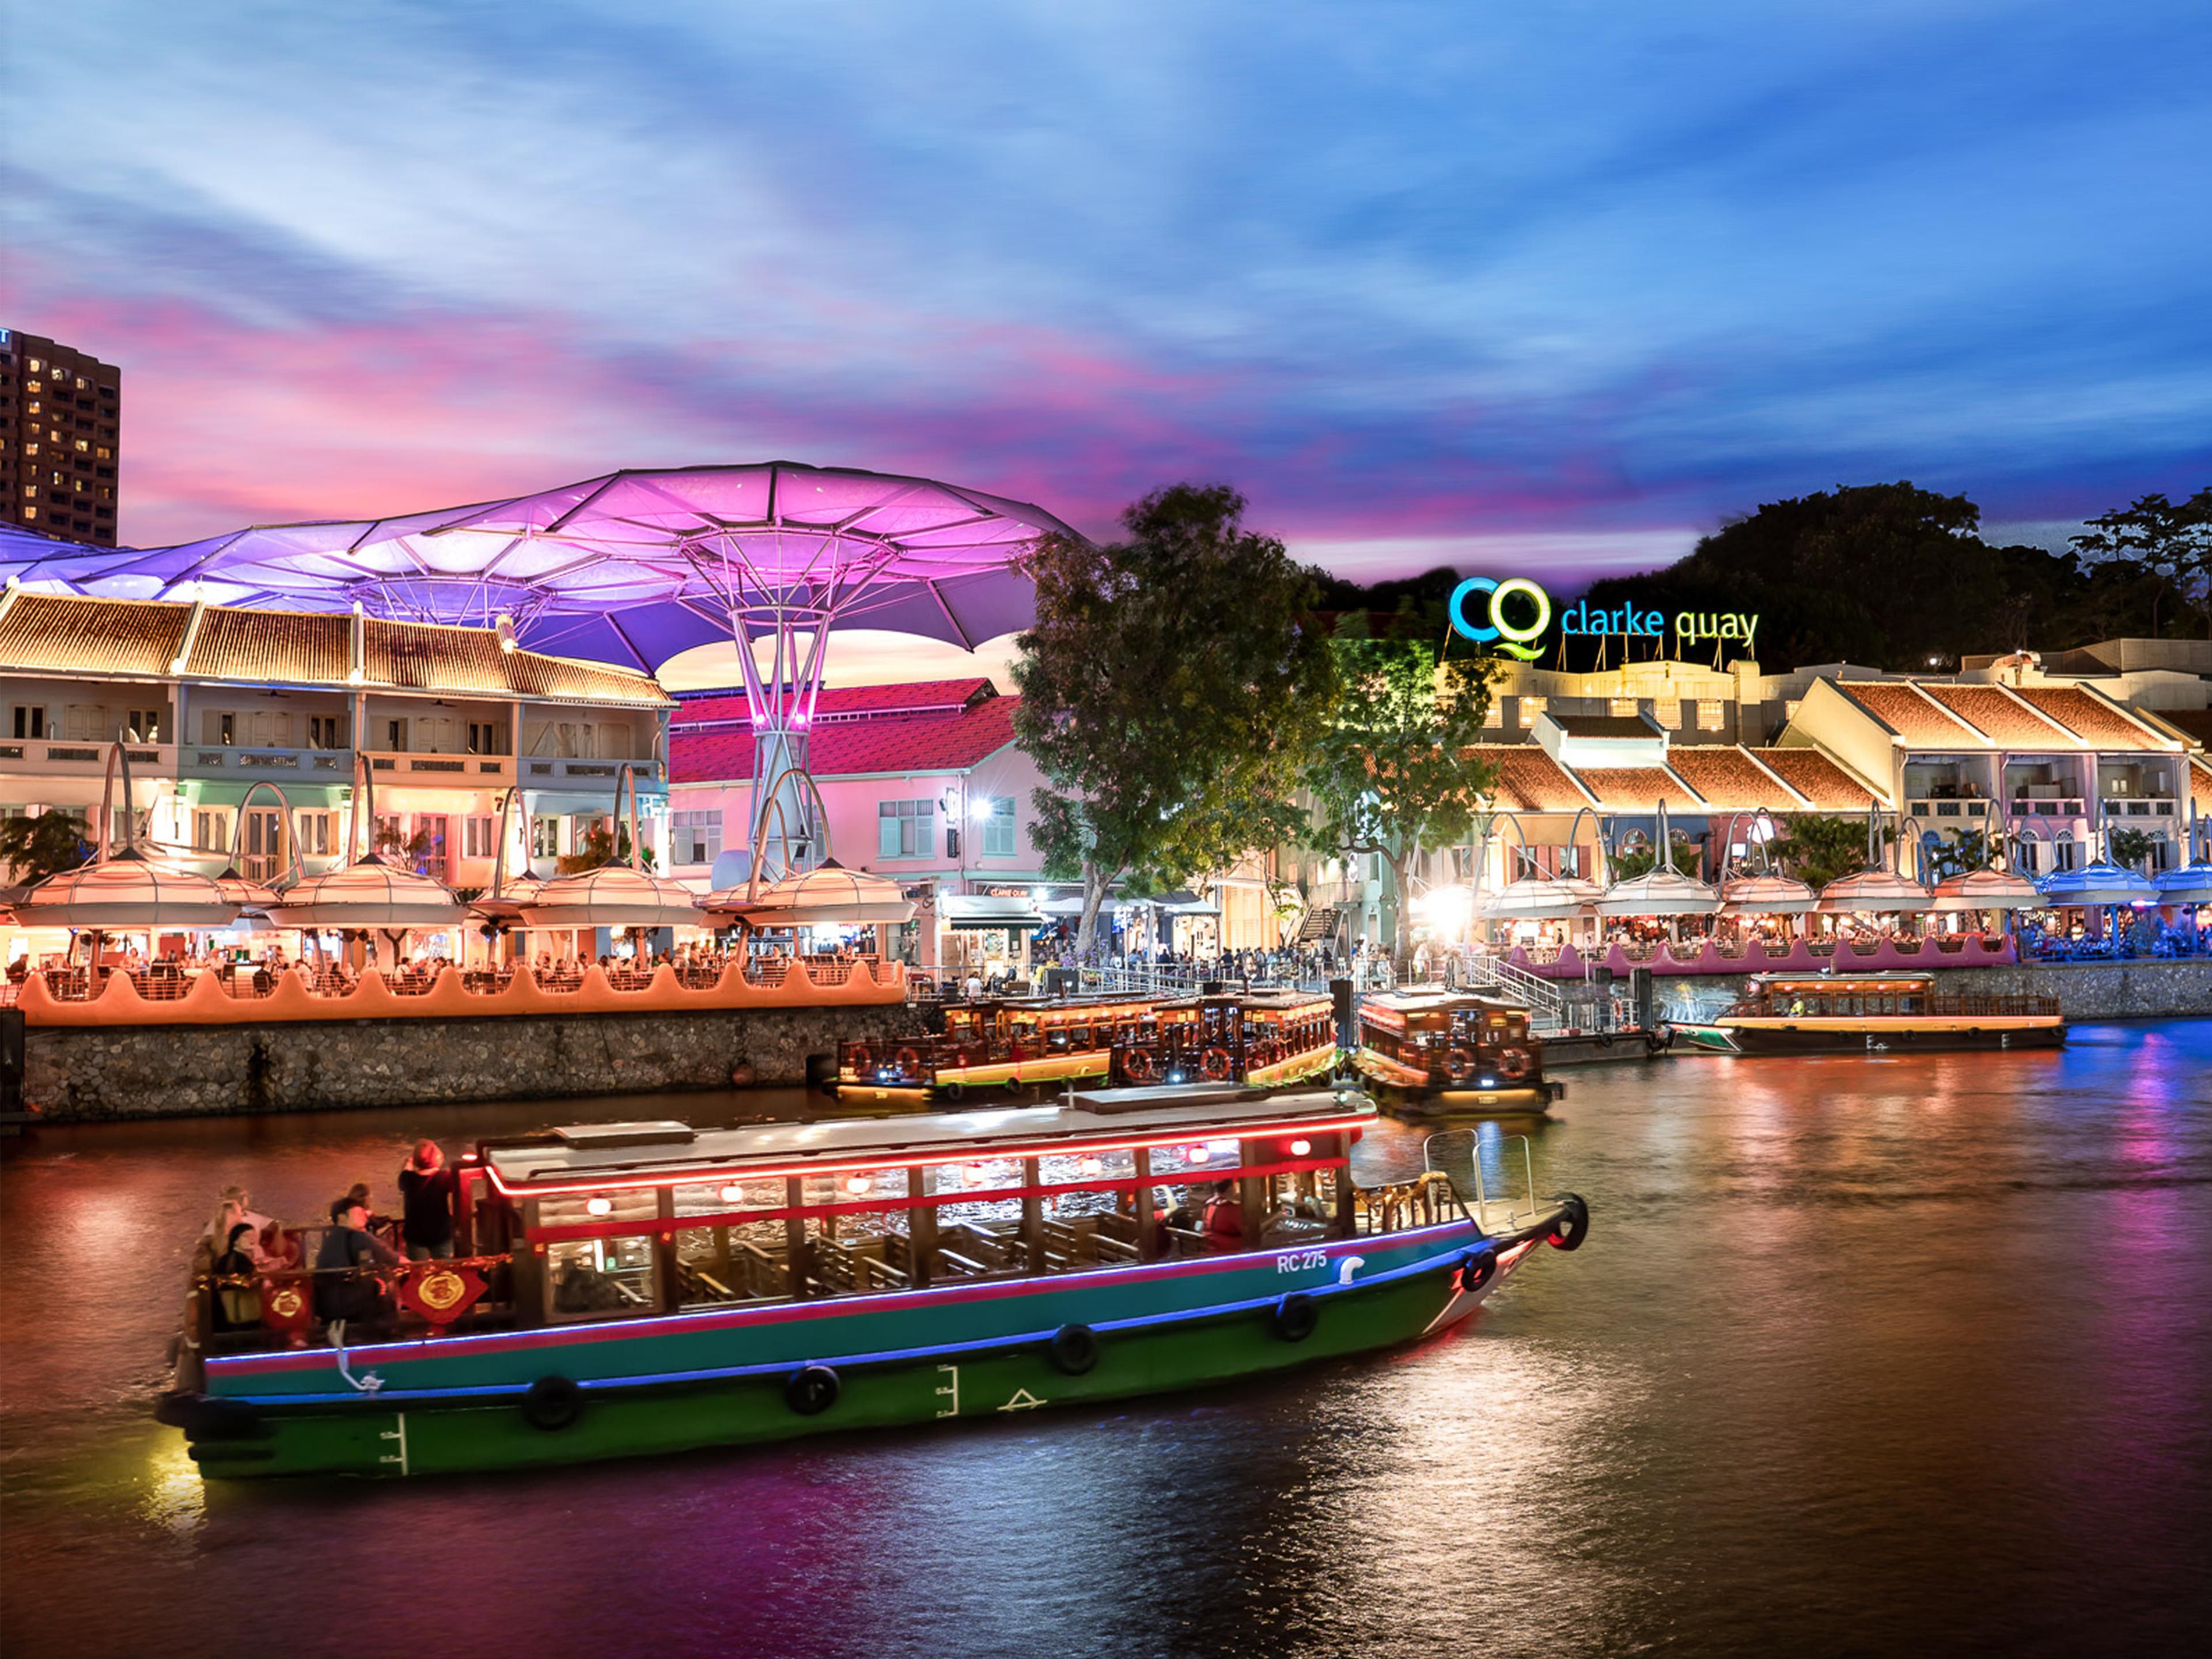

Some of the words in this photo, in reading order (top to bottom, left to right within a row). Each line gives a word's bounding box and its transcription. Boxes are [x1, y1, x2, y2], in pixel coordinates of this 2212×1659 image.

[1561, 600, 1664, 635] clarke
[1675, 611, 1759, 646] quay
[1278, 1255, 1300, 1274] RC
[1301, 1250, 1327, 1269] 275
